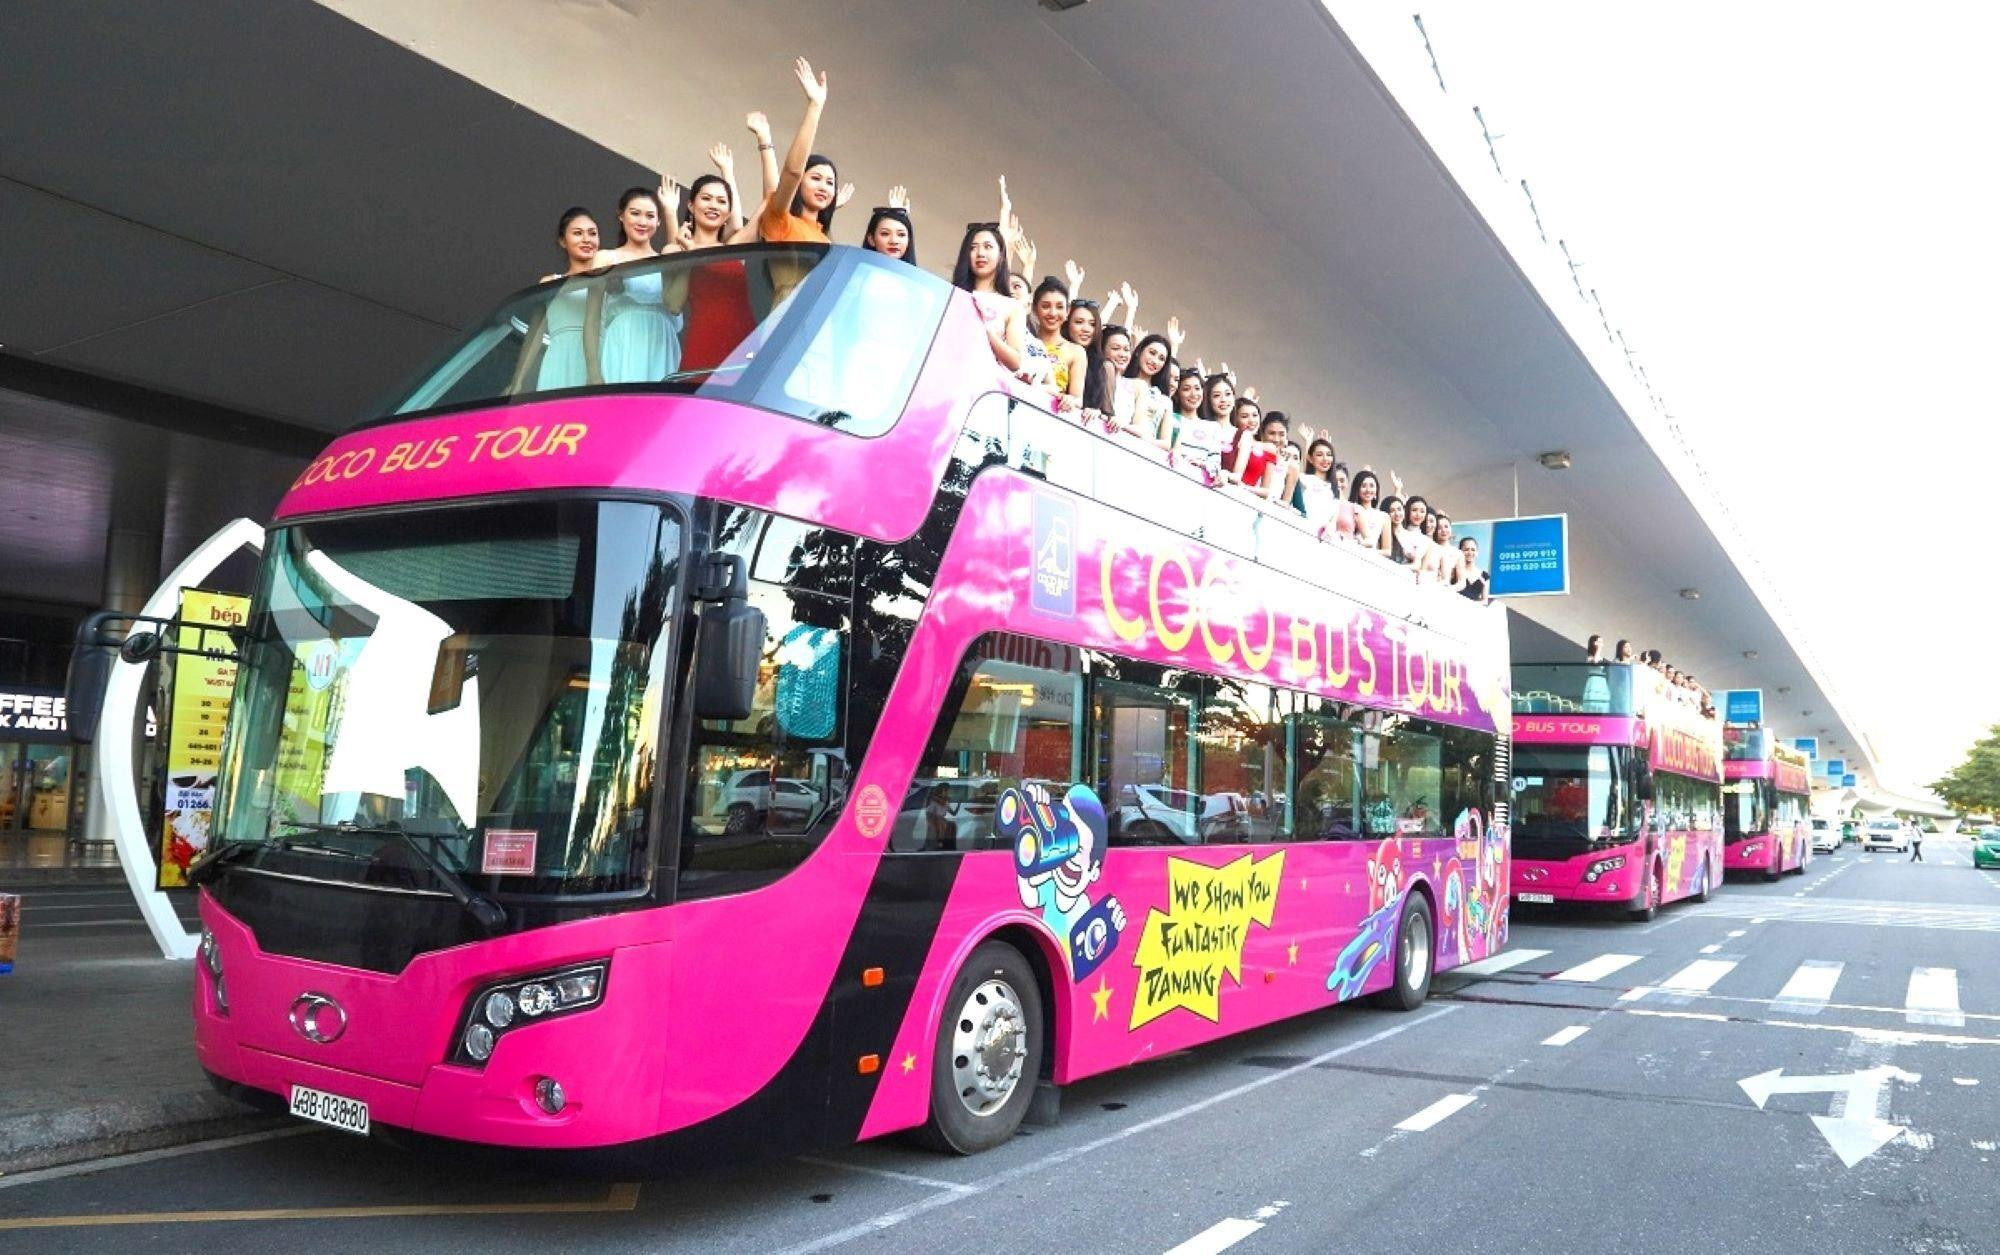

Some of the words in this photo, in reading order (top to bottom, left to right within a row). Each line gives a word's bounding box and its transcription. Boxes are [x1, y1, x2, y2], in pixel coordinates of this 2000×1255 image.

[290, 447, 376, 491] COCO
[379, 435, 459, 474] BUS
[468, 423, 588, 463] TOUR
[210, 605, 242, 627] bếp
[1100, 542, 1275, 672] COCO
[1289, 610, 1377, 697] BUS
[1382, 622, 1463, 715] TOUR
[15, 715, 59, 730] AND
[1525, 722, 1555, 733] BUS
[1560, 722, 1601, 734] TOUR
